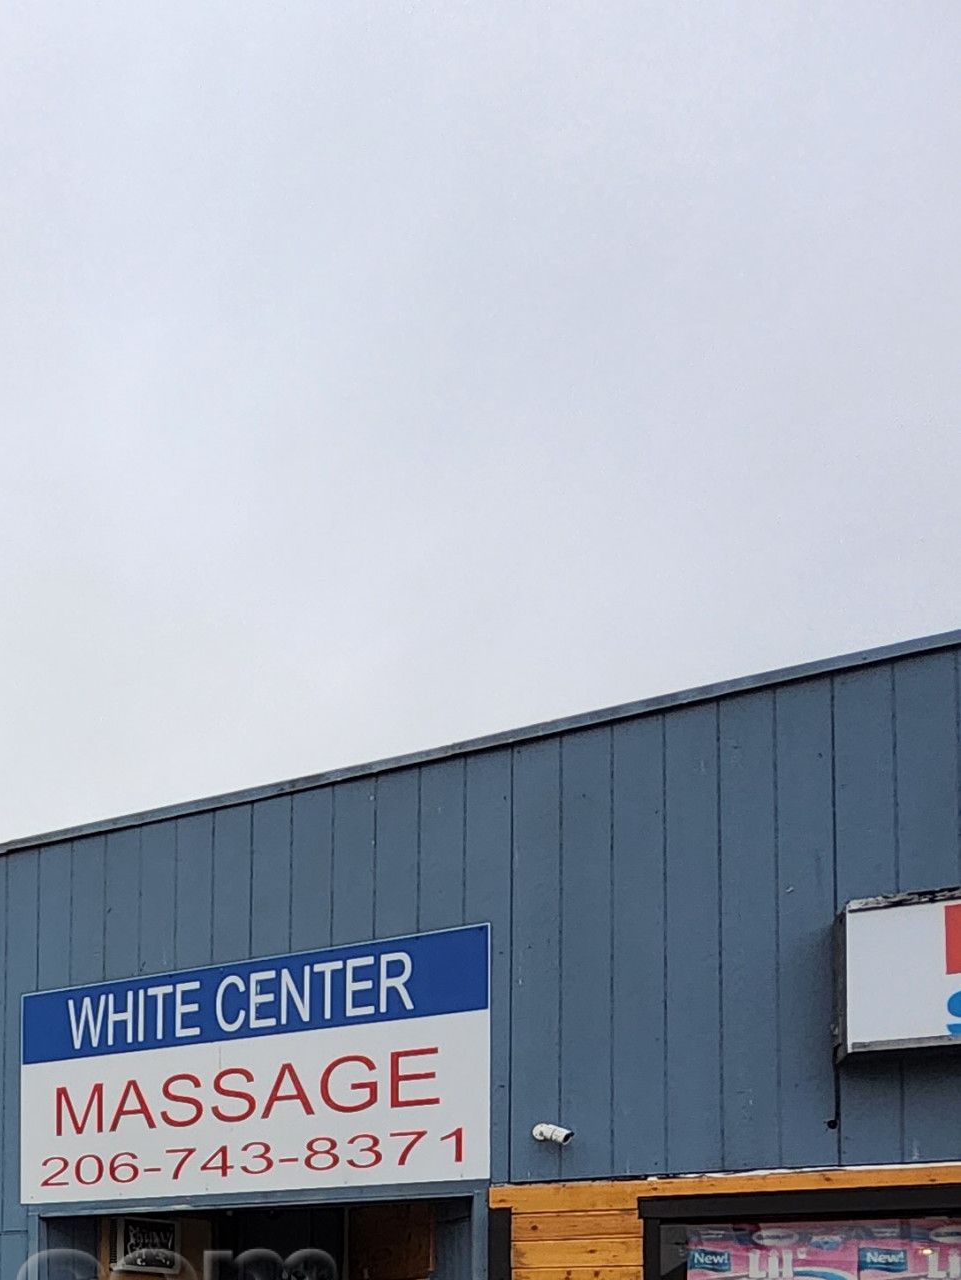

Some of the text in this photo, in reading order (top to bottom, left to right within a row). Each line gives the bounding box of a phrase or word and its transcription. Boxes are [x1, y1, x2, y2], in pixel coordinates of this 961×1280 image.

[67, 951, 416, 1051] WHITE CENTER
[55, 1046, 441, 1137] MASSAGE
[39, 1126, 465, 1189] 206-743-8371
[693, 1251, 729, 1265] New!
[865, 1250, 906, 1265] New!
